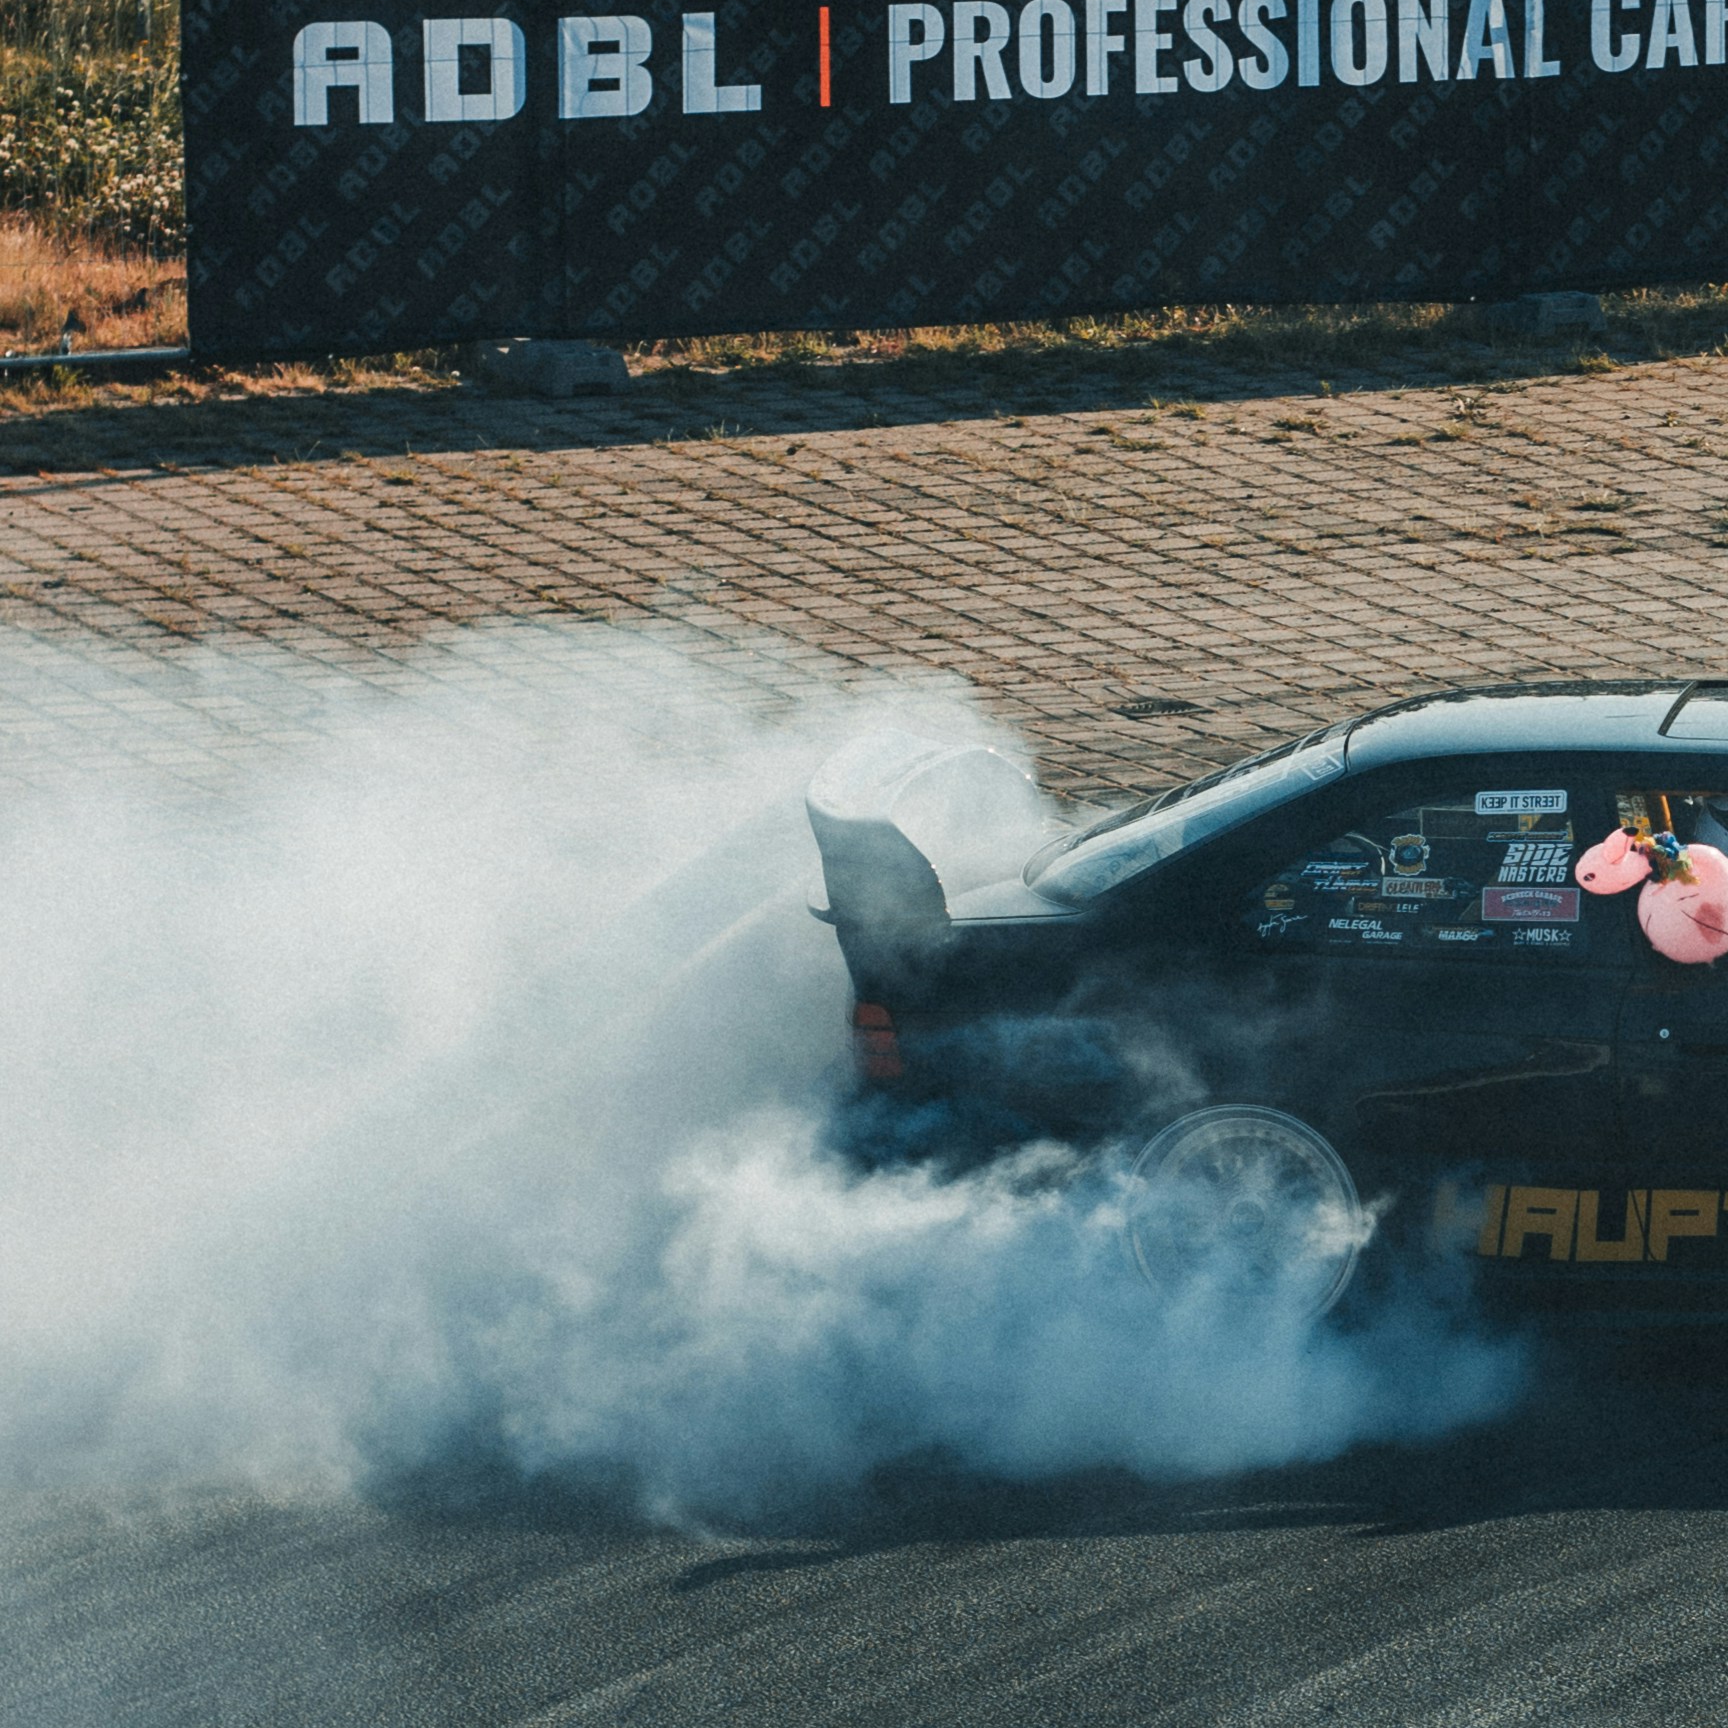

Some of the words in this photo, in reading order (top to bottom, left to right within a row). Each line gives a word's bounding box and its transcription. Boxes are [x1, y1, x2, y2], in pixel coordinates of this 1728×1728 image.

[293, 11, 762, 126] ADBL
[1510, 796, 1520, 808] IT
[1502, 843, 1574, 866] SIDE
[1328, 918, 1383, 930] NELEGAL
[1362, 931, 1404, 940] GARAGE
[1526, 928, 1559, 942] MUSK
